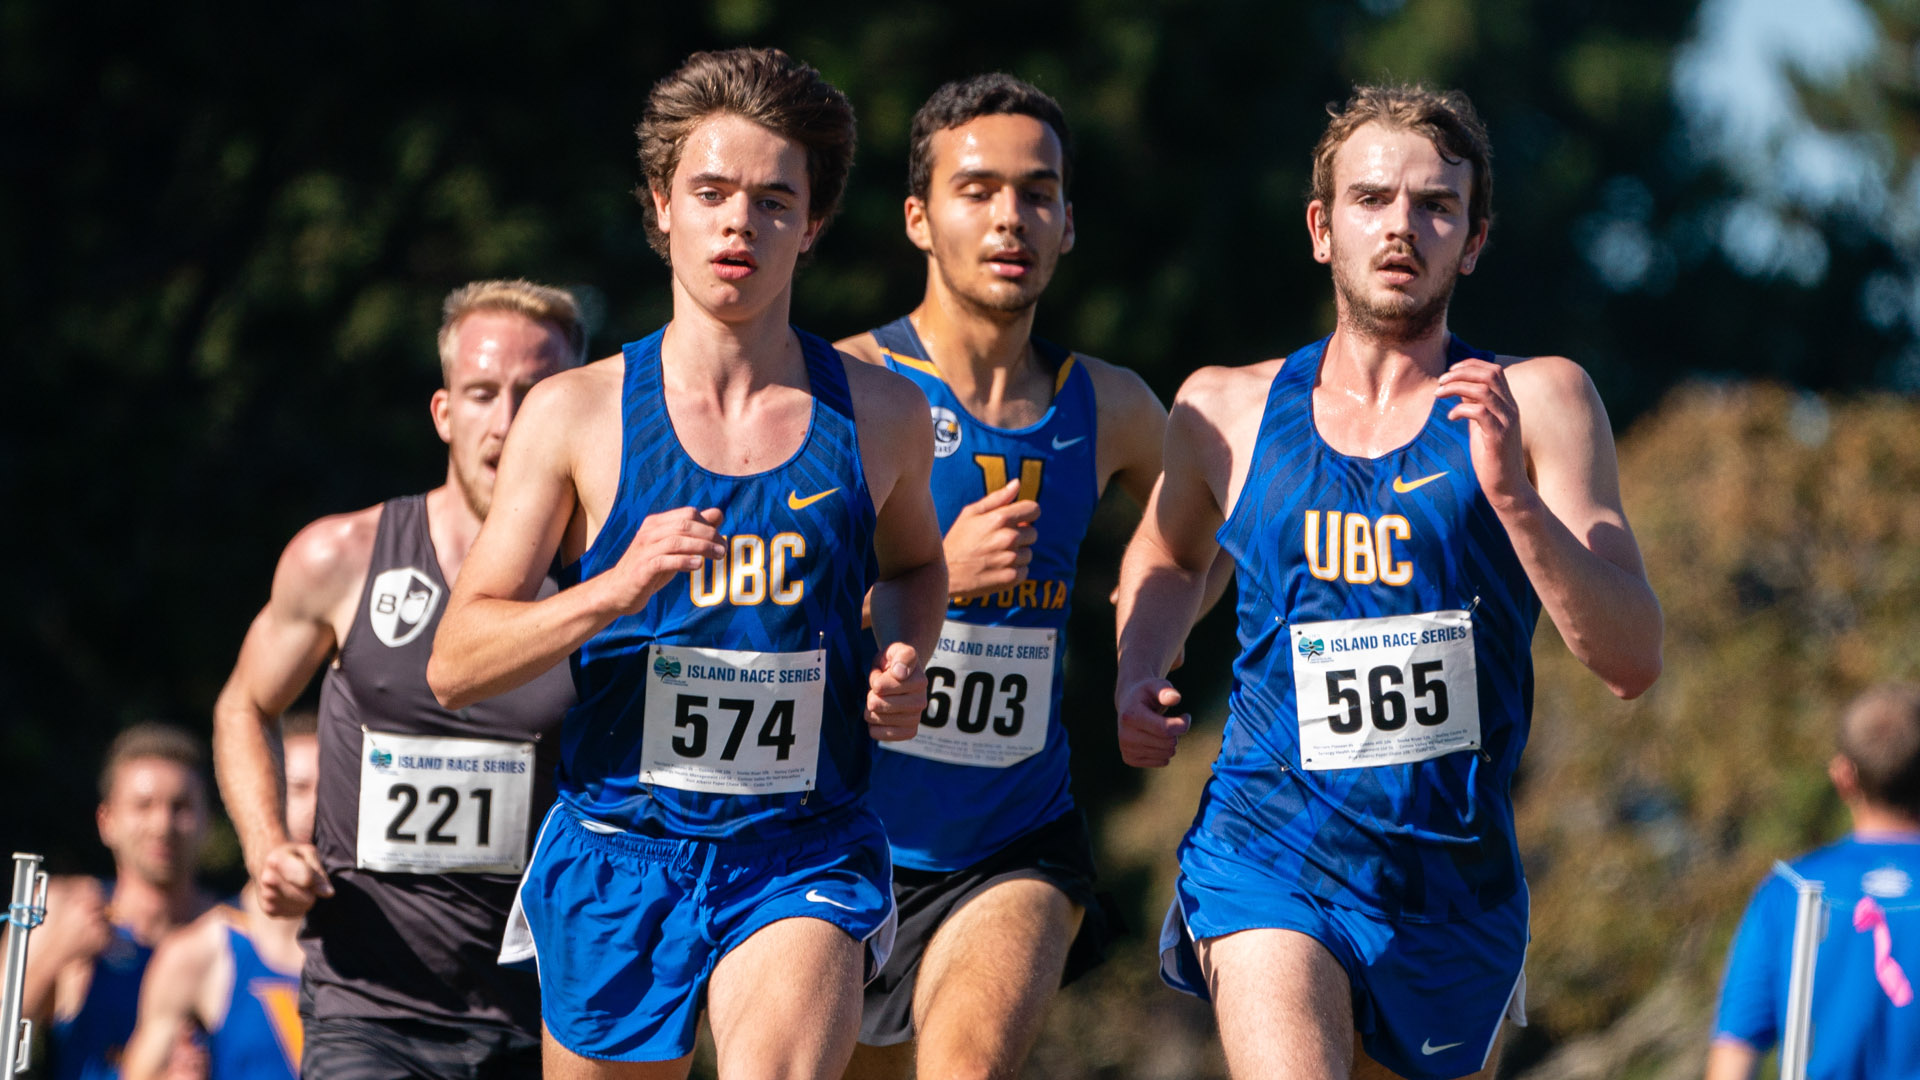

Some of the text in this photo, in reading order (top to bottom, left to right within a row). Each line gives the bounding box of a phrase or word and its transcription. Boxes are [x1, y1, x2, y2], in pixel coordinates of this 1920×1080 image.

[690, 531, 806, 608] UBC
[1304, 510, 1414, 587] UBC
[937, 638, 1050, 660] ISLAND RACE SERIES
[1330, 626, 1467, 653] ISLAND RACE SERIES
[687, 664, 736, 683] ISLAND
[740, 668, 775, 684] RACE
[779, 667, 821, 684] SERIES
[920, 666, 1029, 737] 603
[1325, 659, 1450, 735] 565
[672, 693, 796, 762] 574
[398, 755, 526, 774] ISLAND RACE SERIES
[385, 782, 493, 847] 221
